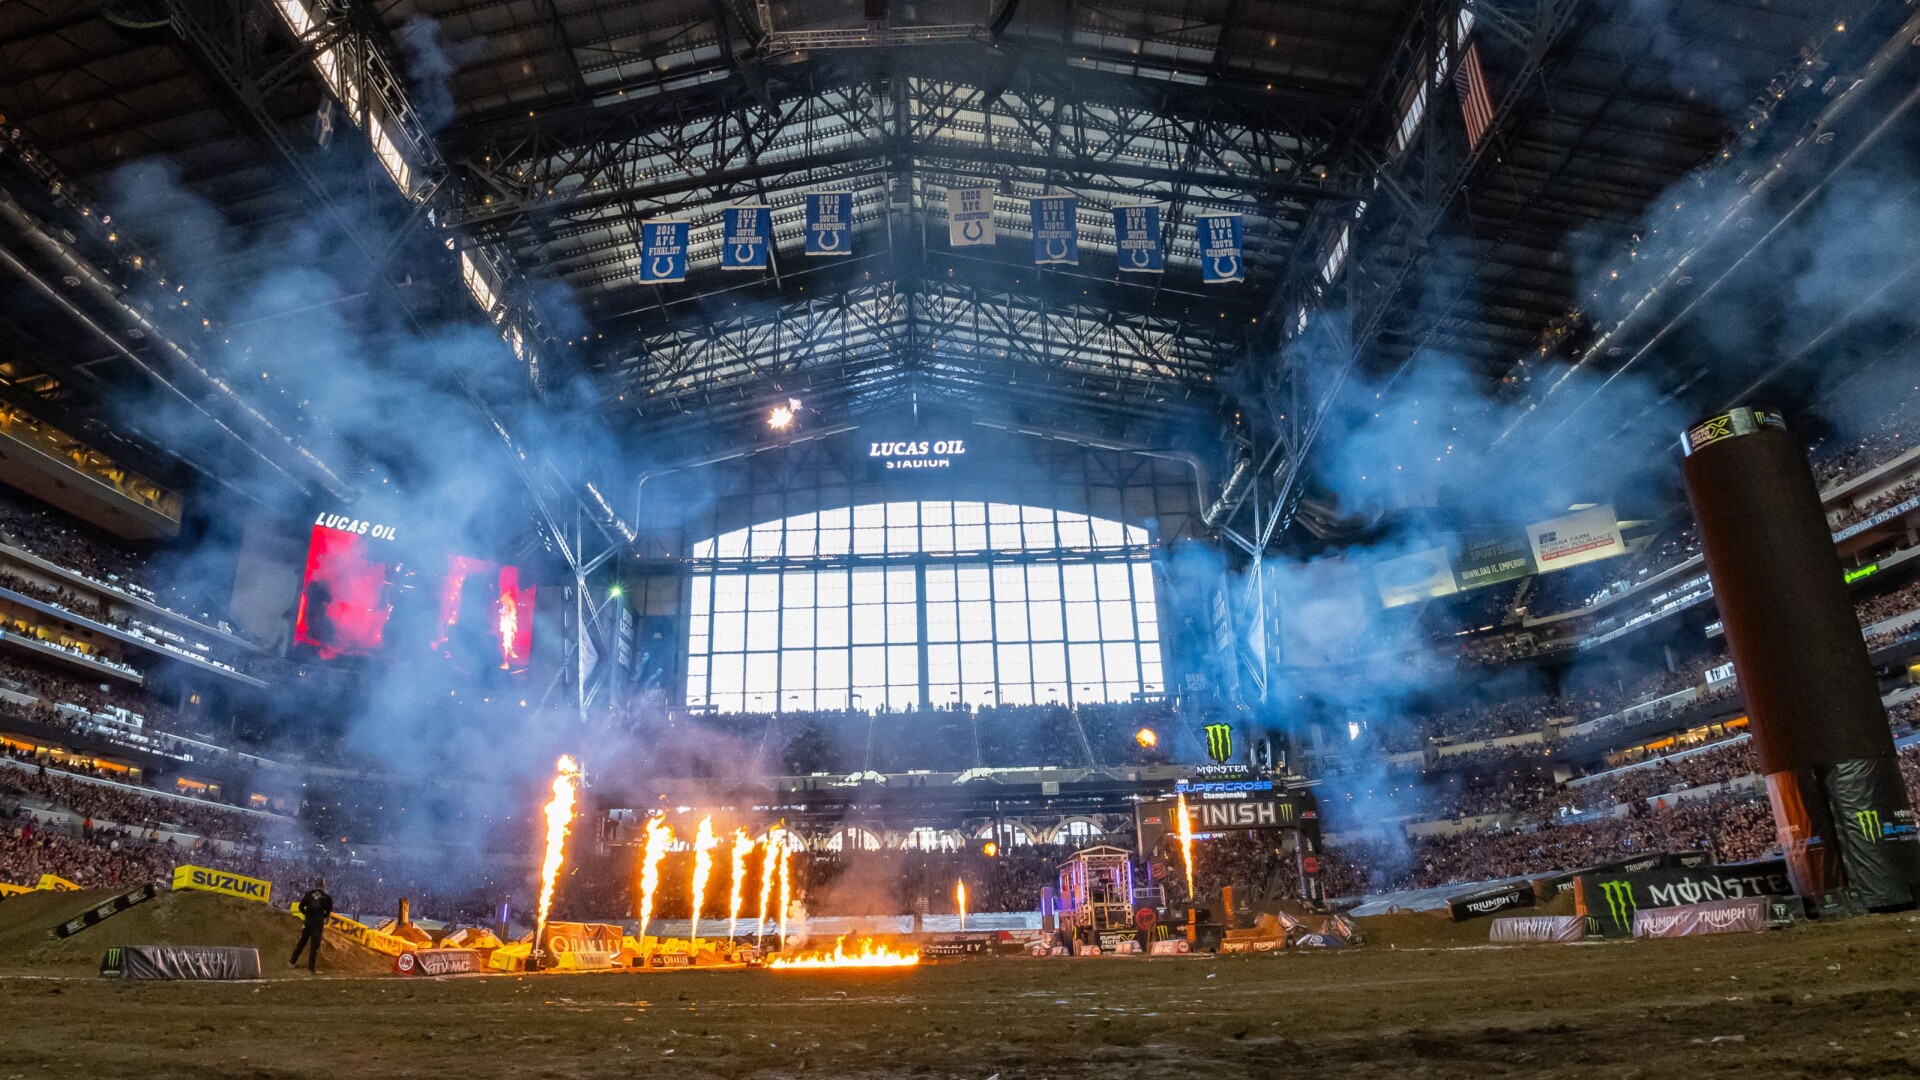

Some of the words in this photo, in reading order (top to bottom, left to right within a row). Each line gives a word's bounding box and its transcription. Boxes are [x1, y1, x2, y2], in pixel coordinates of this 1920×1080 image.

[819, 195, 839, 205] 2010
[819, 205, 839, 214] AFC
[962, 201, 980, 211] AFC
[737, 209, 758, 219] 2013
[819, 214, 839, 223] SOUTH
[954, 211, 990, 221] CHAMPIONS
[1043, 211, 1065, 221] AFC
[1125, 208, 1146, 218] 2007
[736, 219, 756, 228] AFC
[811, 222, 846, 231] CHAMPIONS
[1043, 221, 1066, 230] SOUTH
[1126, 217, 1147, 229] AFC
[1208, 217, 1232, 229] 2006
[655, 224, 676, 236] 2014
[736, 228, 756, 236] SOUTH
[1037, 230, 1073, 239] CHAMPIONS
[1127, 230, 1148, 240] SOUTH
[1210, 228, 1233, 240] AFC
[655, 235, 675, 246] AFC
[728, 236, 763, 244] CHAMPIONS
[1120, 240, 1156, 250] CHAMPIONS
[1211, 239, 1234, 249] SOUTH
[648, 245, 681, 257] FINALIST
[1205, 248, 1241, 258] CHAMPIONS
[869, 441, 930, 457] LUCAS
[933, 440, 966, 455] OIL
[886, 458, 950, 469] STADIUM
[1832, 520, 1873, 542] ARCHIBRODA
[1874, 508, 1899, 524] 1975-79
[1900, 498, 1919, 512] 92-95
[314, 511, 370, 535] LUCAS
[371, 524, 396, 541] OIL
[1539, 538, 1569, 549] INDIANA
[1569, 532, 1590, 543] FARM
[1540, 543, 1570, 555] BUREAU
[1570, 532, 1613, 547] INSURANCE
[1586, 543, 1597, 552] ON
[1461, 566, 1492, 580] DOWNLOAD
[1196, 764, 1249, 774] MONSTER
[1176, 781, 1274, 793] SUPERCROSS
[1203, 791, 1247, 799] Championship
[1186, 802, 1277, 826] FINISH
[1624, 859, 1655, 873] TRIUMPH
[192, 870, 266, 897] SUZUKI
[1557, 880, 1575, 892] TRIU
[1648, 873, 1790, 907] MONSTE
[1466, 895, 1511, 913] TRIUMPH
[1698, 906, 1746, 927] TRIUMPH
[325, 917, 367, 938] ZUKI
[1639, 914, 1680, 933] TRIUMPH
[1223, 941, 1245, 953] TRIUMPH
[1253, 941, 1276, 951] TRIUMPH
[163, 949, 227, 967] MONSTER
